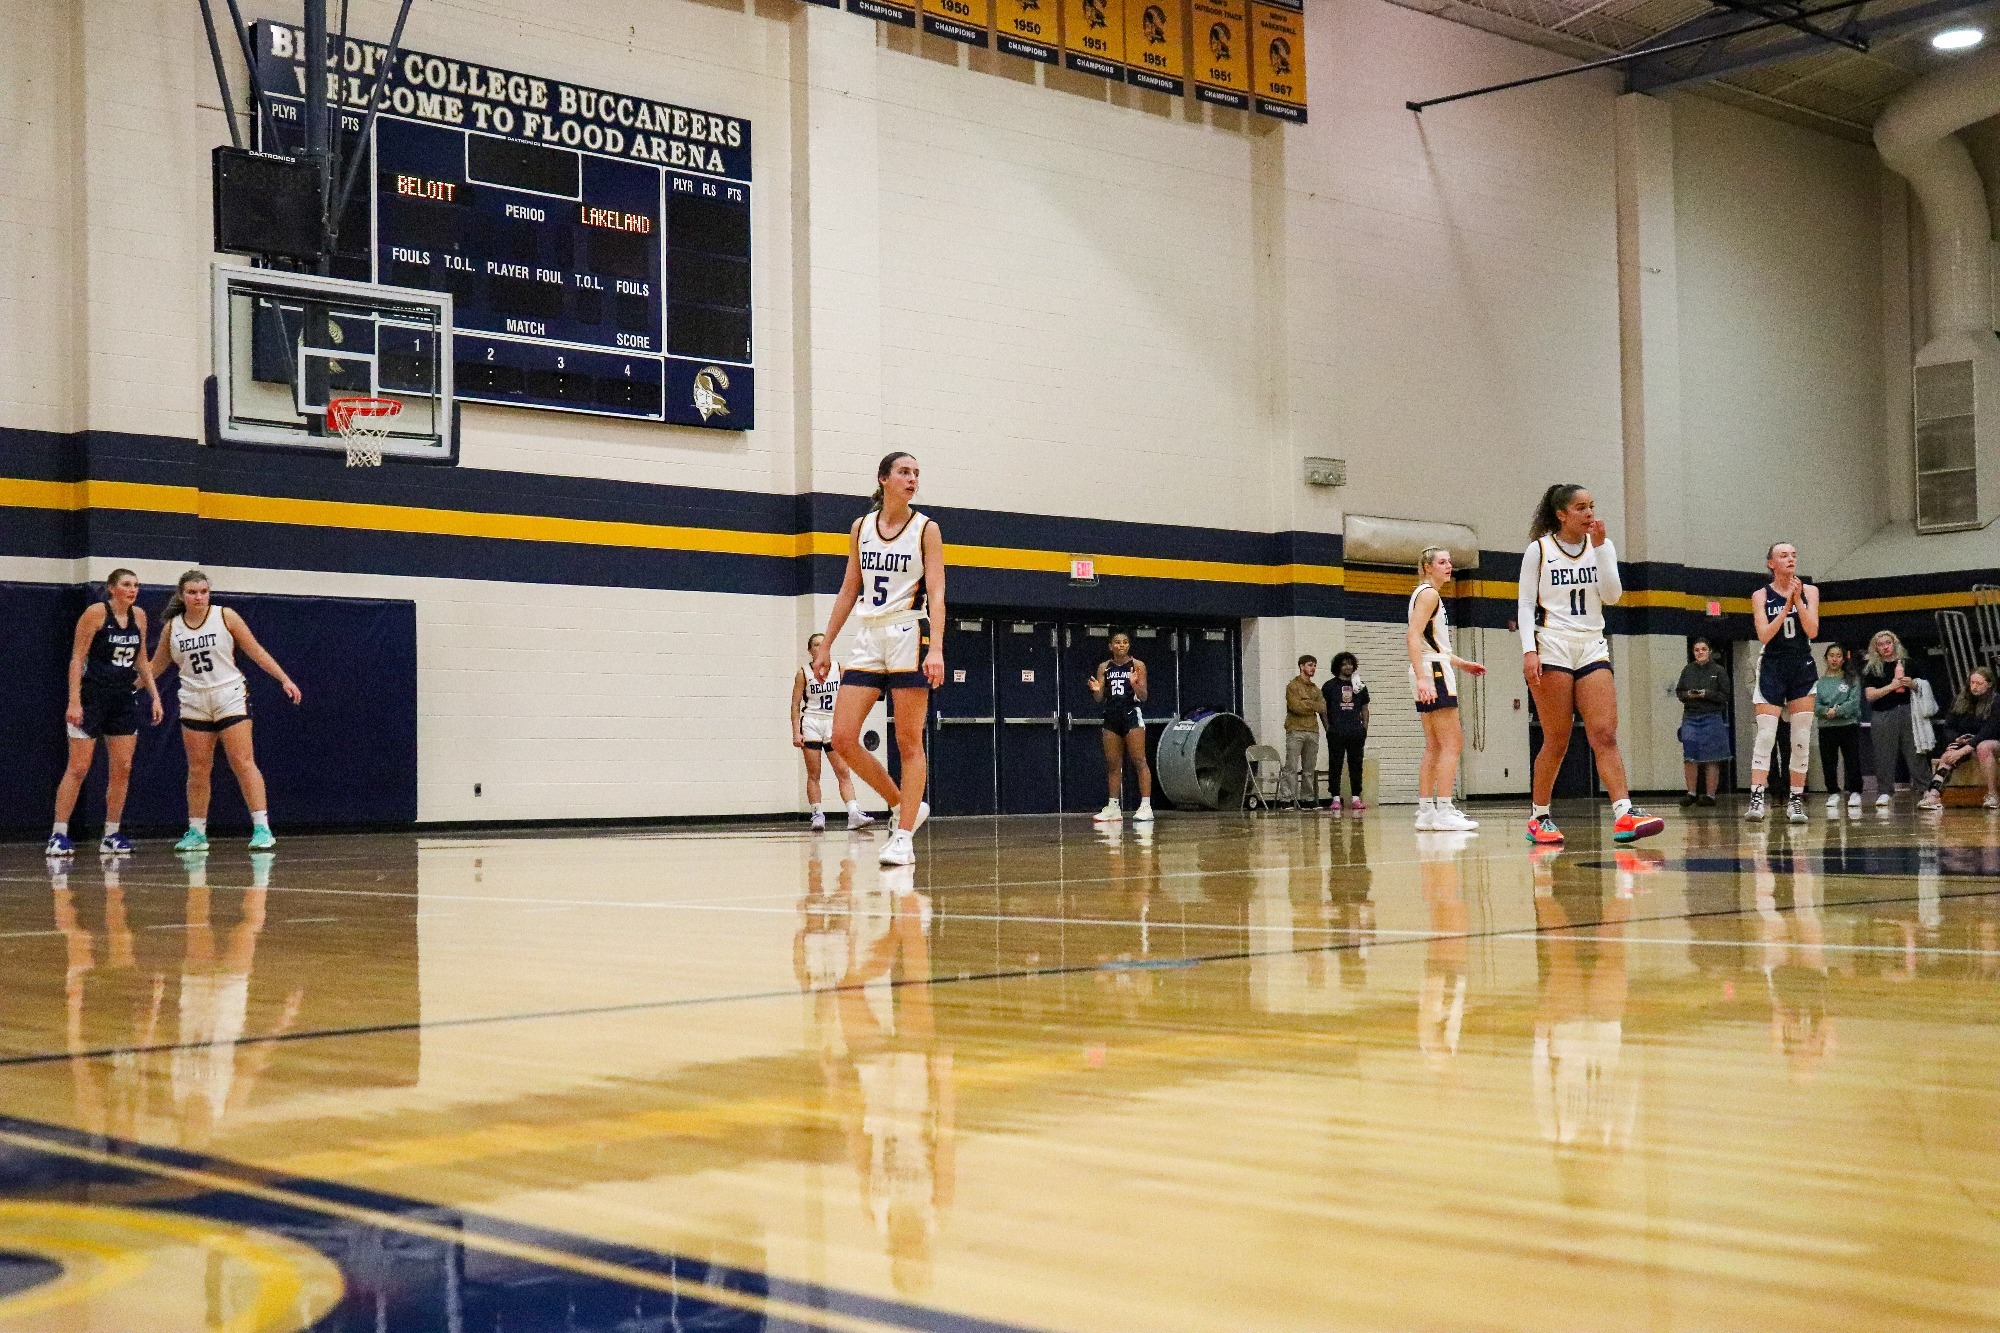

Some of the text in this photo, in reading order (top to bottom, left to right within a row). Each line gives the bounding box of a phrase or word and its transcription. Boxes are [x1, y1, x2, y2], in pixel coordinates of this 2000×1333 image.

[859, 1, 903, 19] CHAMPIONS
[941, 0, 970, 16] 1950
[934, 21, 976, 39] CHAMPIONS
[1013, 18, 1041, 35] 1950
[1008, 41, 1048, 58] CHAMPIONS
[1082, 35, 1107, 52] 1951
[1076, 58, 1114, 74] CHAMPIONS
[1142, 51, 1167, 68] 1951
[1137, 74, 1174, 89] CHAMPIONS
[1209, 67, 1232, 83] 1951
[1204, 89, 1239, 104] CHAMPIONS
[1269, 82, 1293, 97] 1967
[404, 54, 549, 110] COLLEGE
[558, 84, 742, 147] BUCCANEERS
[271, 103, 360, 132] PLYR PTS
[1264, 103, 1298, 117] CHAMPIONS
[472, 101, 515, 133] TO
[522, 110, 625, 154] FLOOD
[630, 134, 726, 174] ARENA
[248, 150, 296, 163] DAKTRONICS
[397, 174, 456, 202] BELOIT
[673, 177, 743, 202] PLYR FLS PTS
[505, 203, 546, 222] PERIOD
[580, 206, 651, 234] LAKELAND
[392, 247, 650, 297] FOULS T.O.L. PLAYER FOUL T.O.L. FOULS
[506, 318, 546, 336] MATCH
[616, 333, 651, 349] SCORE
[413, 338, 632, 377] 1 2 3 4
[861, 551, 912, 573] BELOIT
[1550, 566, 1598, 586] BELOIT
[872, 575, 890, 607] 5
[1569, 588, 1587, 616] 11
[1767, 604, 1807, 616] LAKA
[1783, 616, 1796, 639] 0
[178, 633, 217, 653] BELOIT
[111, 646, 136, 668] 52
[189, 650, 214, 675] 25
[810, 681, 839, 695] BELOIT
[1110, 679, 1125, 696] 25
[819, 694, 833, 711] 12
